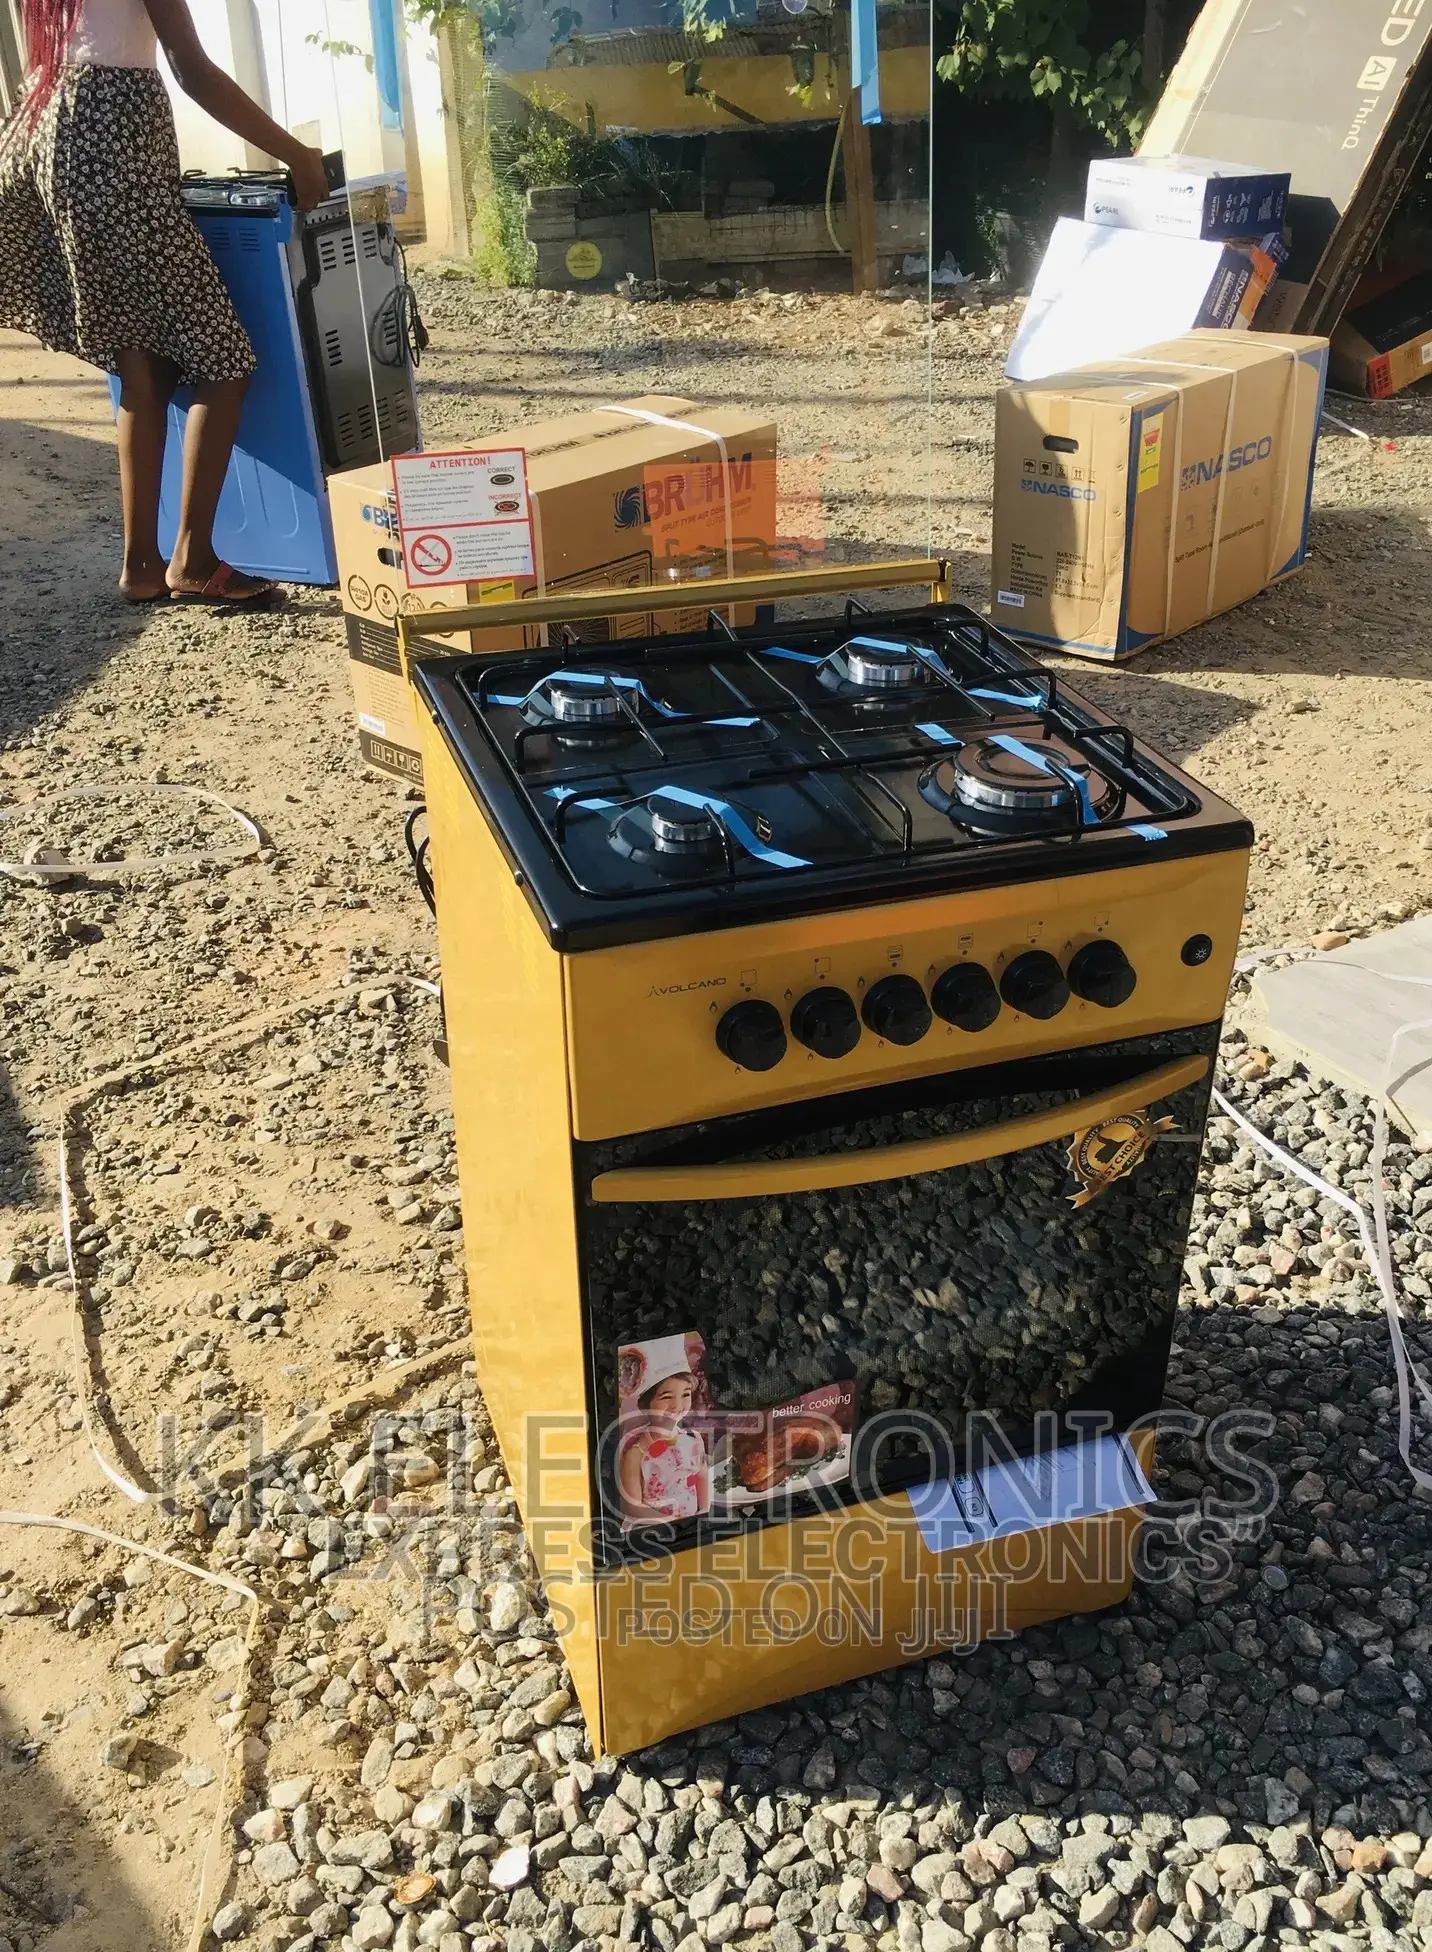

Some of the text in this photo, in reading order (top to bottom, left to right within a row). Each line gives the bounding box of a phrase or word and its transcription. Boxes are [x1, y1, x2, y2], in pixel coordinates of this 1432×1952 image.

[1364, 60, 1388, 86] AI
[1341, 96, 1380, 150] ThinQ
[429, 456, 491, 469] ATTENTION!
[487, 466, 516, 474] CORRECT
[1196, 435, 1272, 485] NASCO
[488, 492, 522, 501] INCORRECT
[1033, 481, 1096, 501] NASCO
[660, 978, 727, 994] VOLCANO
[1102, 1116, 1140, 1128] BEST QUALITY
[1080, 1127, 1099, 1165] BEST QUALITY
[1115, 1130, 1146, 1164] CHOICE
[772, 1393, 851, 1418] better cooking
